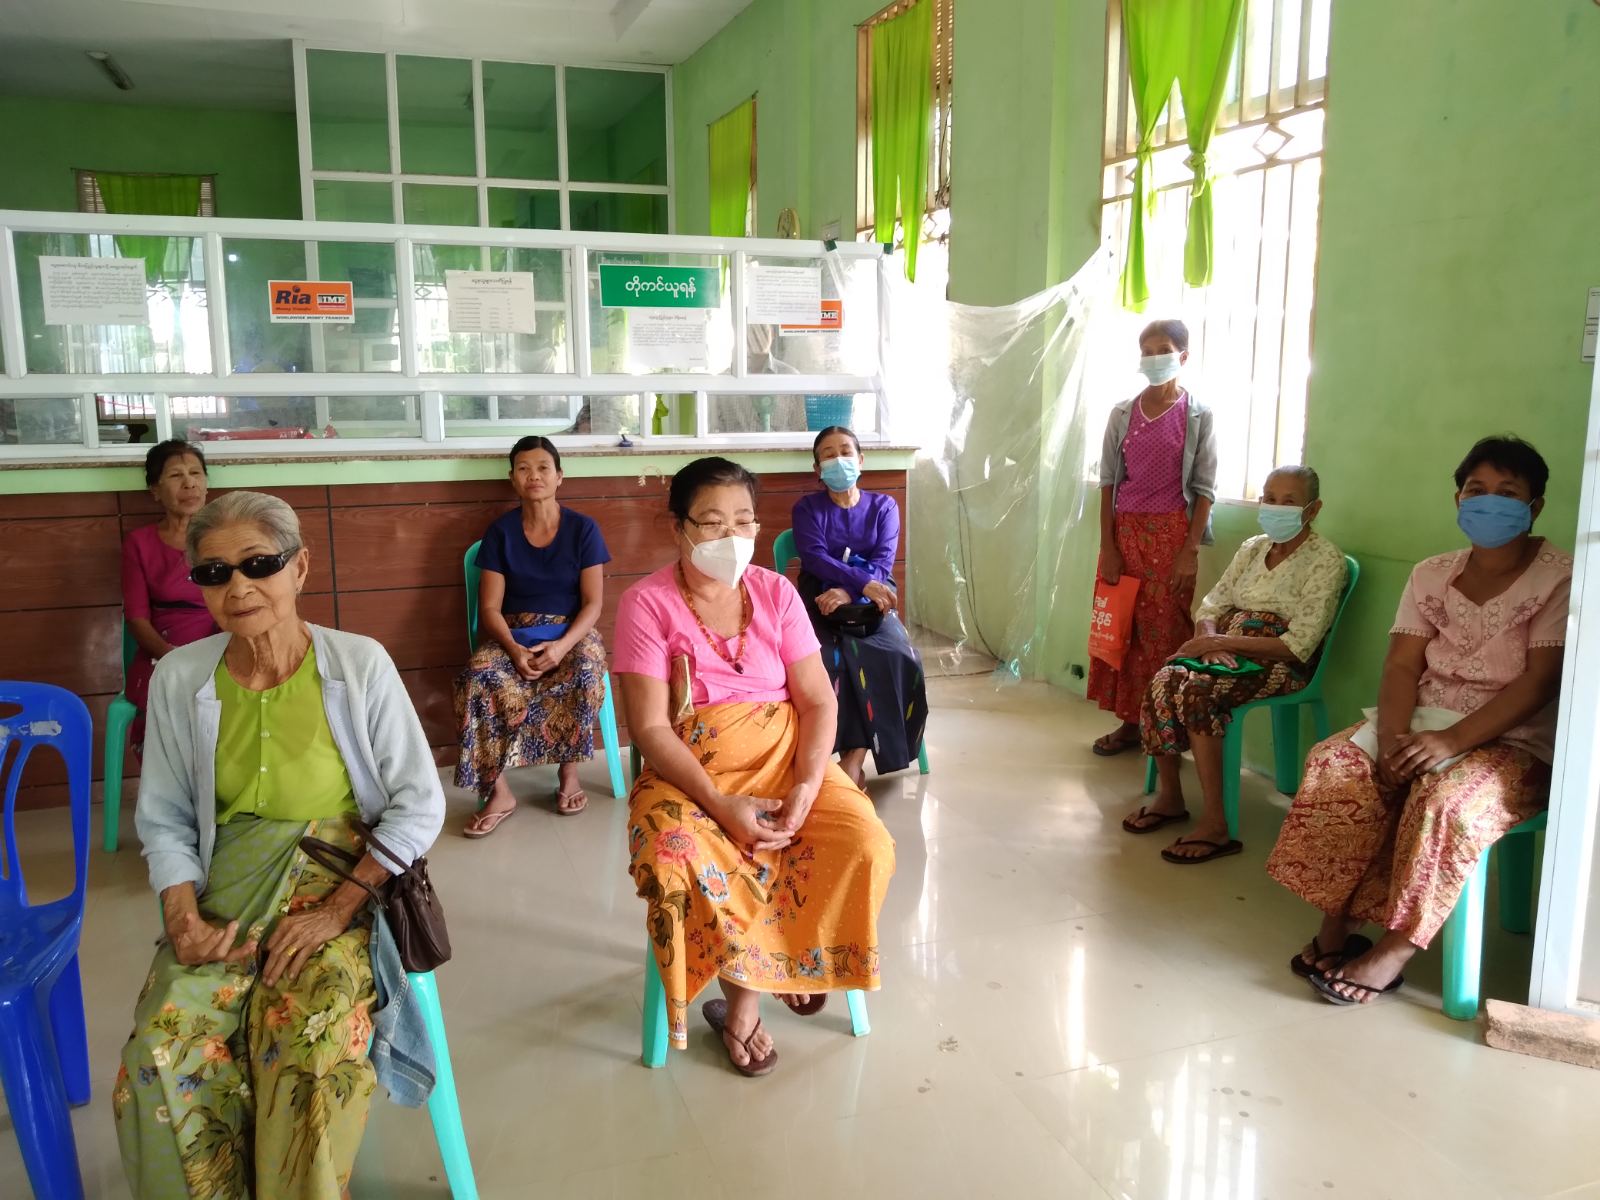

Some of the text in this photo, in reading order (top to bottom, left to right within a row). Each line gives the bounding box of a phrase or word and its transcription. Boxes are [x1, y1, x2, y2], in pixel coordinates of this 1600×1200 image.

[275, 285, 312, 305] Ria
[625, 275, 697, 299] တိုကင်ယူရန်
